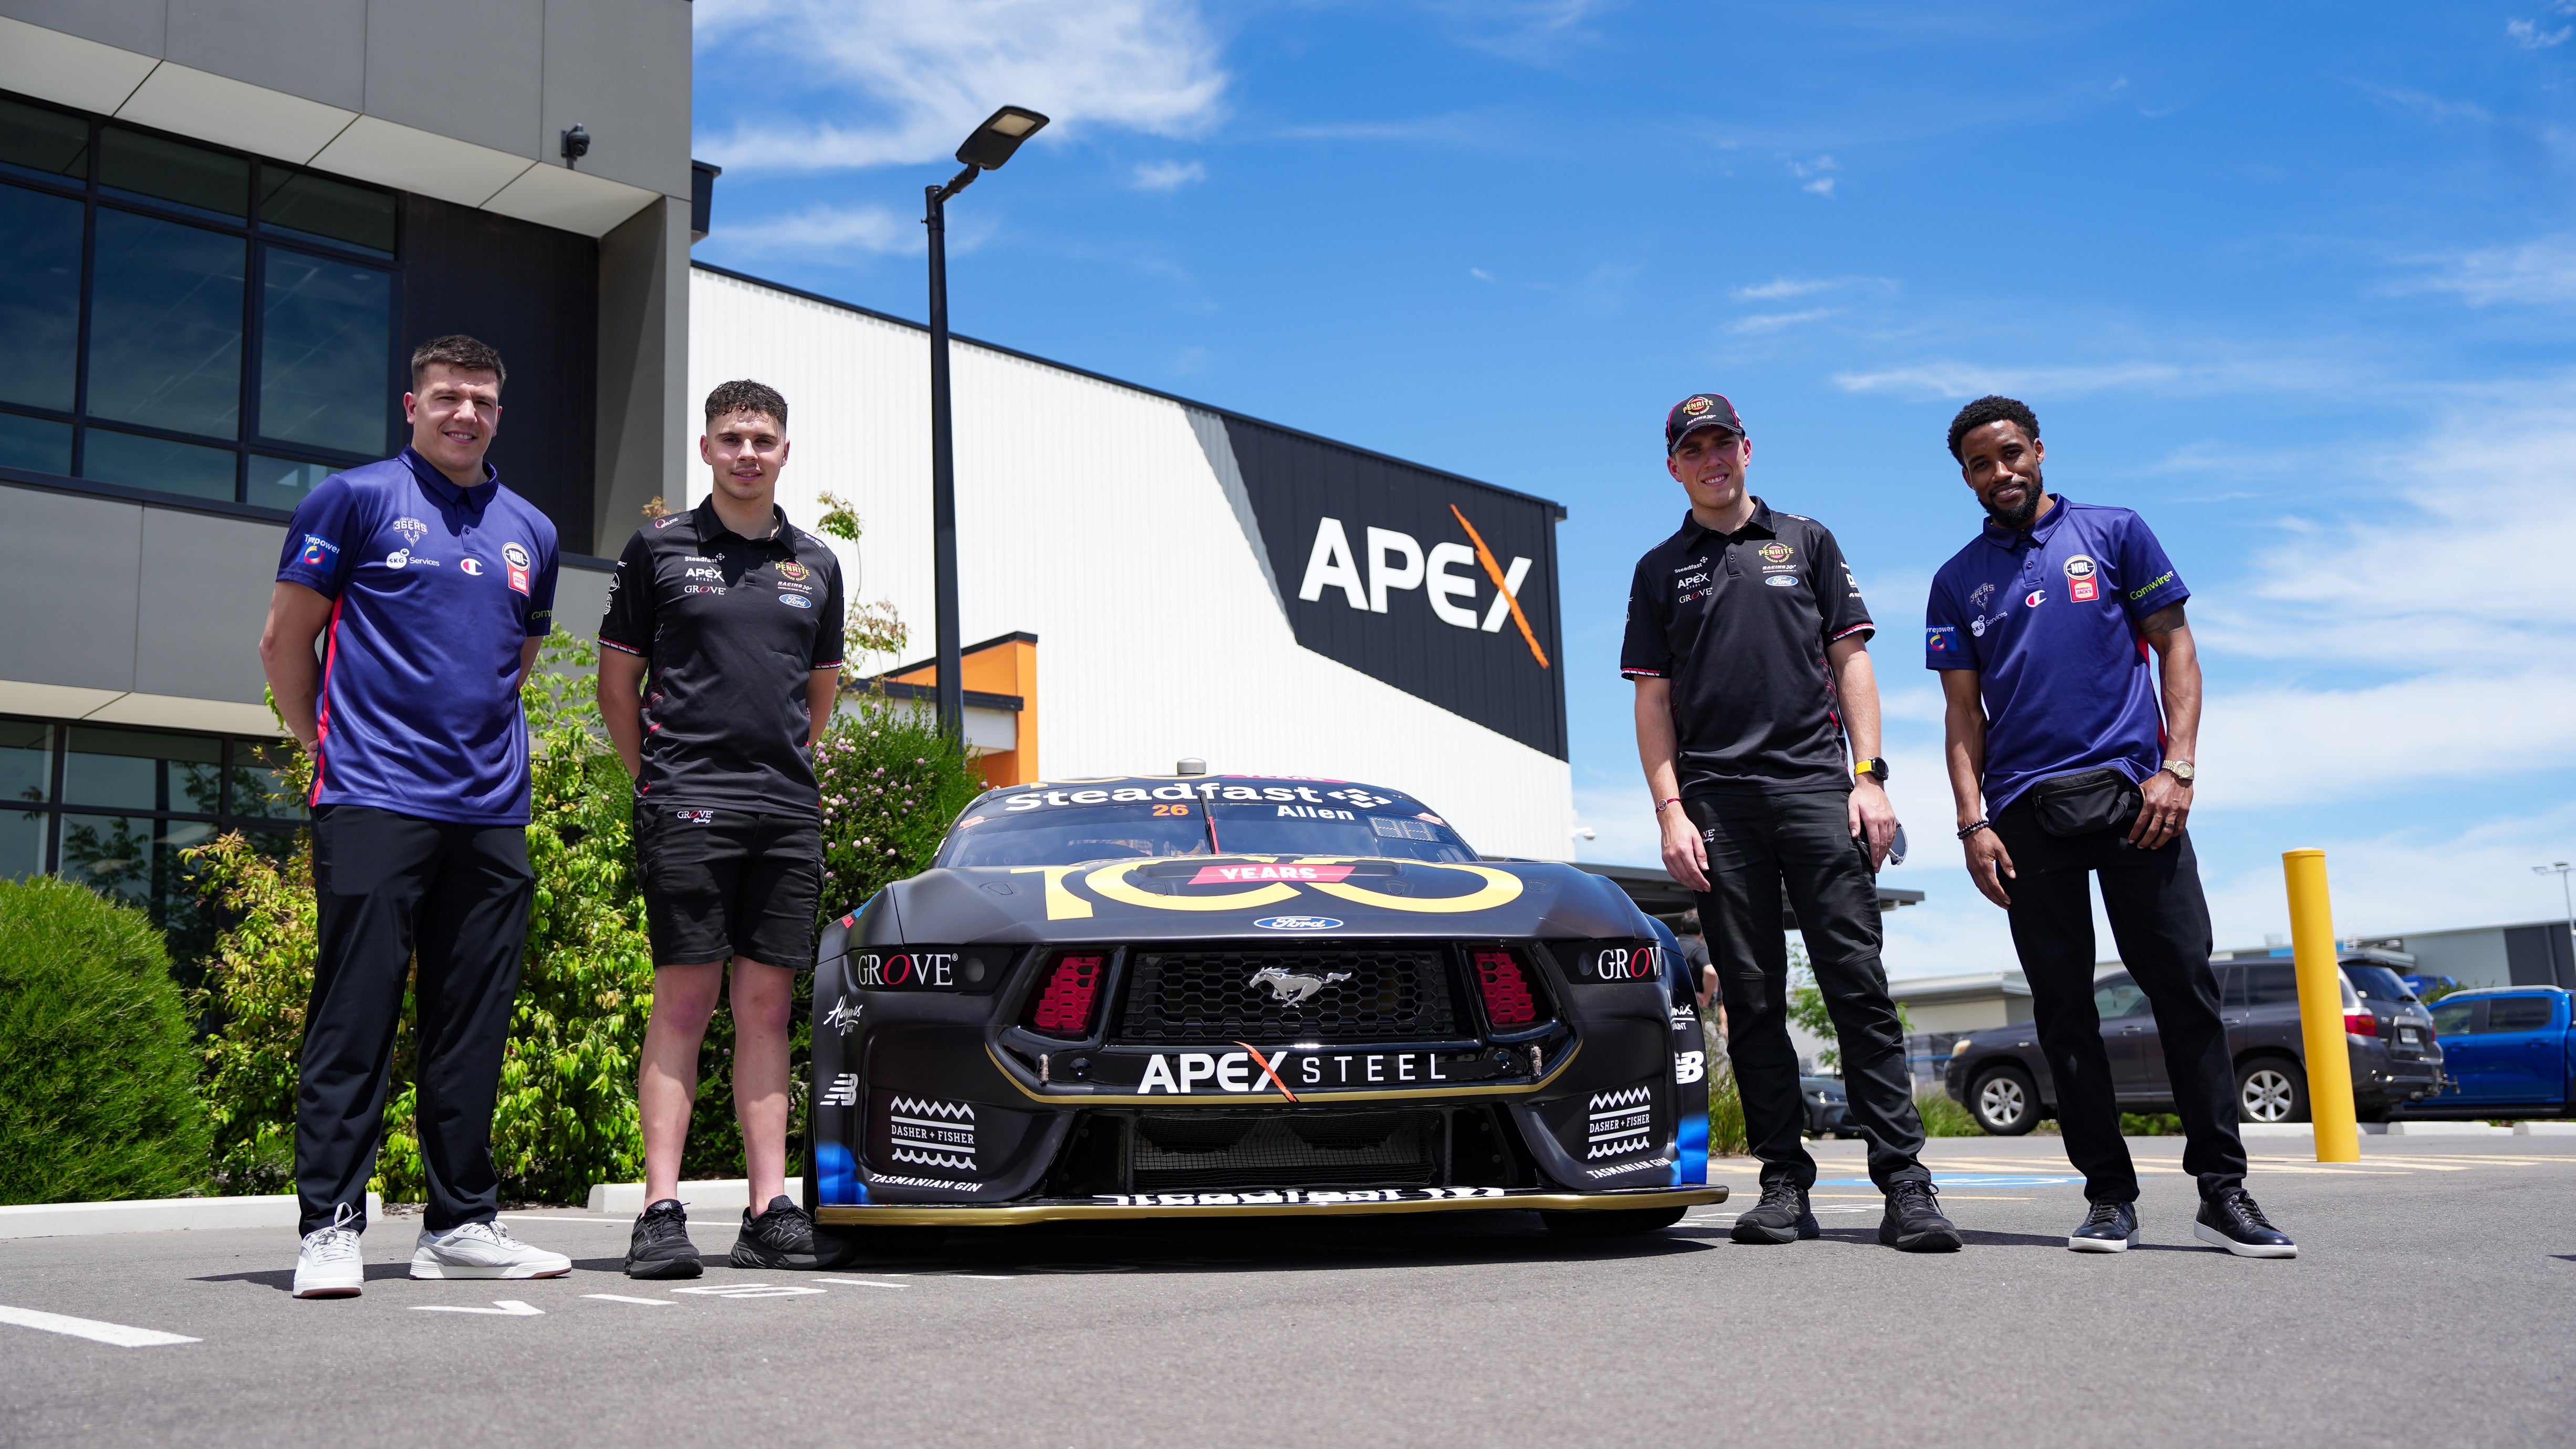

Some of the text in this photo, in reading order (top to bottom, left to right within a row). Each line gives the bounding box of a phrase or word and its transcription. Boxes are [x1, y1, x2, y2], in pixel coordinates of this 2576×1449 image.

[1683, 400, 1714, 414] PENRITE
[1687, 415, 1707, 426] RACING
[394, 520, 427, 533] 36ERS
[305, 534, 340, 554] Tyrepower
[1758, 548, 1794, 556] PENRITE
[410, 556, 440, 567] Services
[508, 549, 525, 565] NBL
[685, 566, 725, 582] APEX
[775, 563, 810, 576] PENRITE
[1674, 562, 1703, 573] Steadfast
[2071, 562, 2090, 574] NBL
[1299, 503, 1549, 669] APEX
[1677, 572, 1711, 589] APEX
[1970, 584, 1995, 603] 36ERS
[1973, 611, 2008, 633] SKG Services
[1004, 783, 1322, 812] Steadfast
[1152, 804, 1188, 816] 26
[1277, 805, 1355, 821] Allen
[1219, 865, 1318, 880] YEARS
[823, 993, 863, 1036] Haymes
[1138, 1041, 1446, 1102] APEX STEEL
[1589, 1119, 1619, 1133] DASHER
[1626, 1114, 1650, 1127] FISHER
[891, 1125, 927, 1139] DASHER
[937, 1130, 974, 1144] FISHER
[1586, 1157, 1672, 1179] TASMANIAN GIN
[869, 1173, 983, 1192] TASMANIAN GIN
